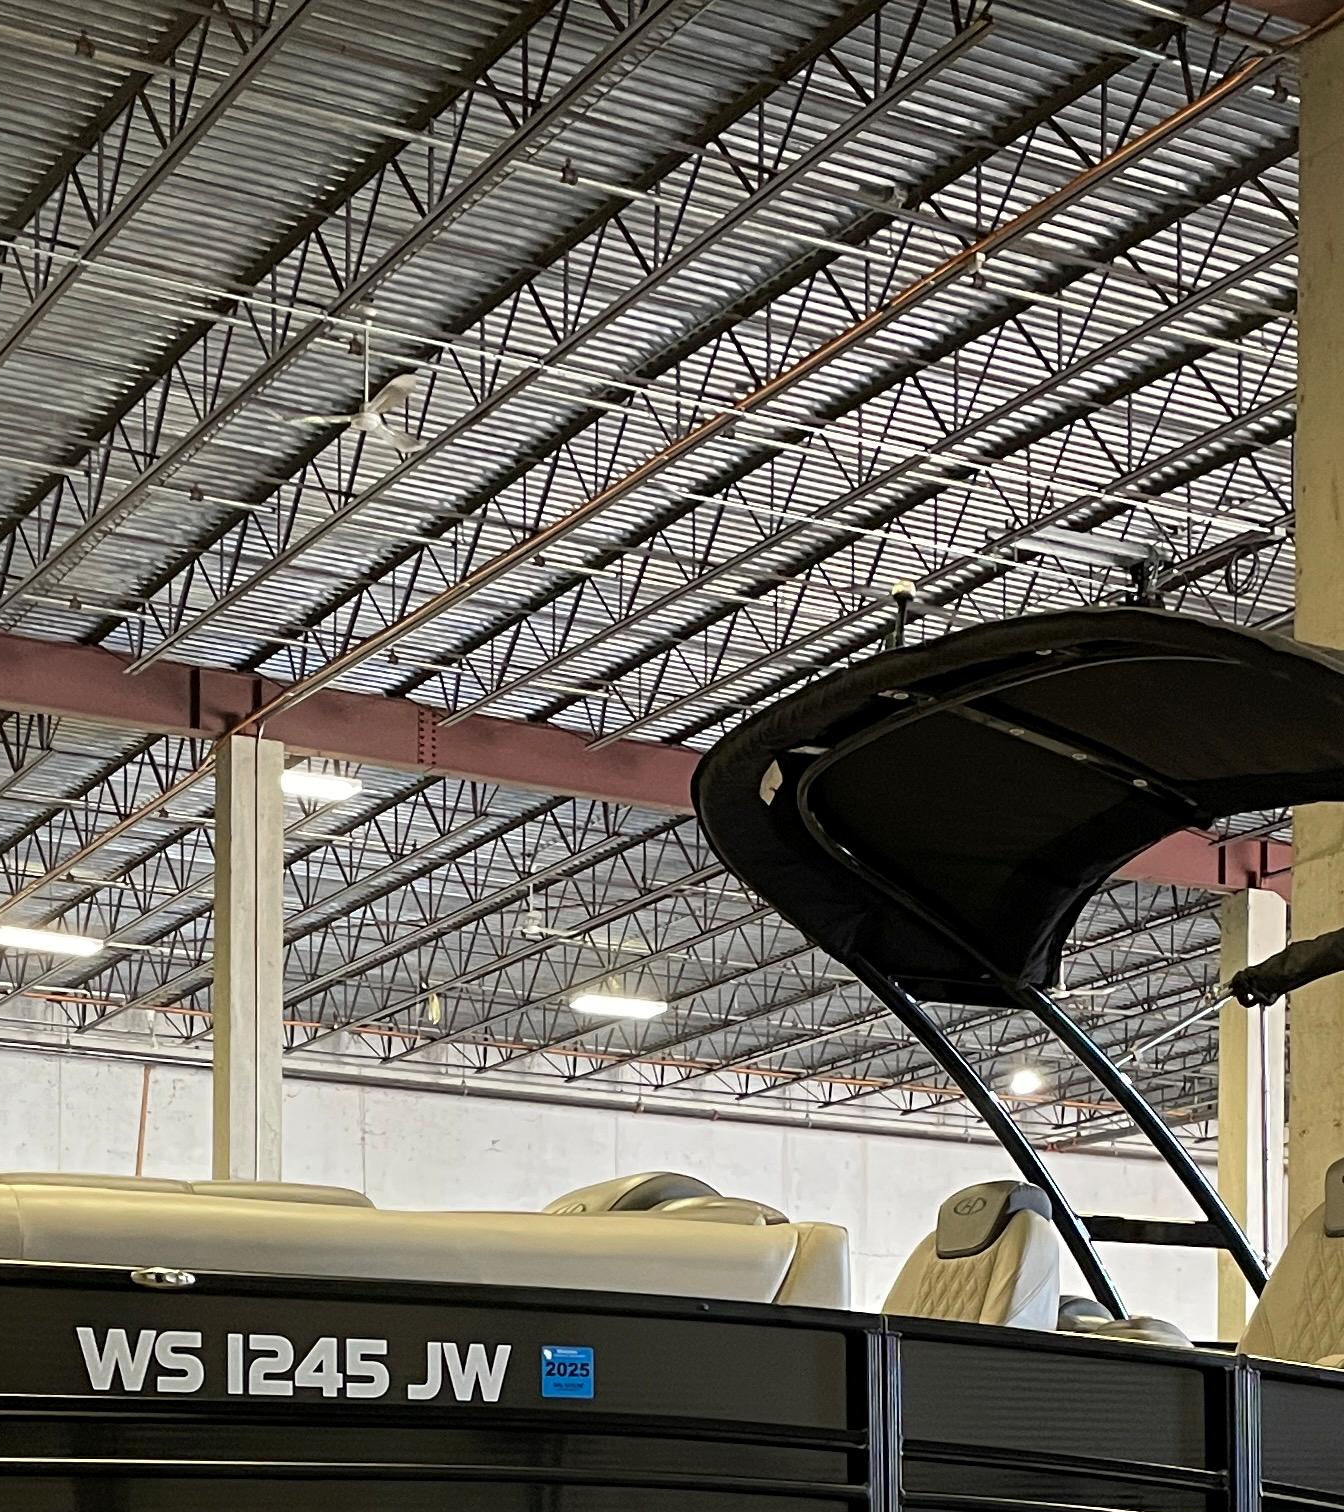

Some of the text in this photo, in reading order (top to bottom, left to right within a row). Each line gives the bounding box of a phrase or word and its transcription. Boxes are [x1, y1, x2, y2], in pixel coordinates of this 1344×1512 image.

[76, 1326, 512, 1402] WS 1245 JW
[545, 1361, 590, 1378] 2025
